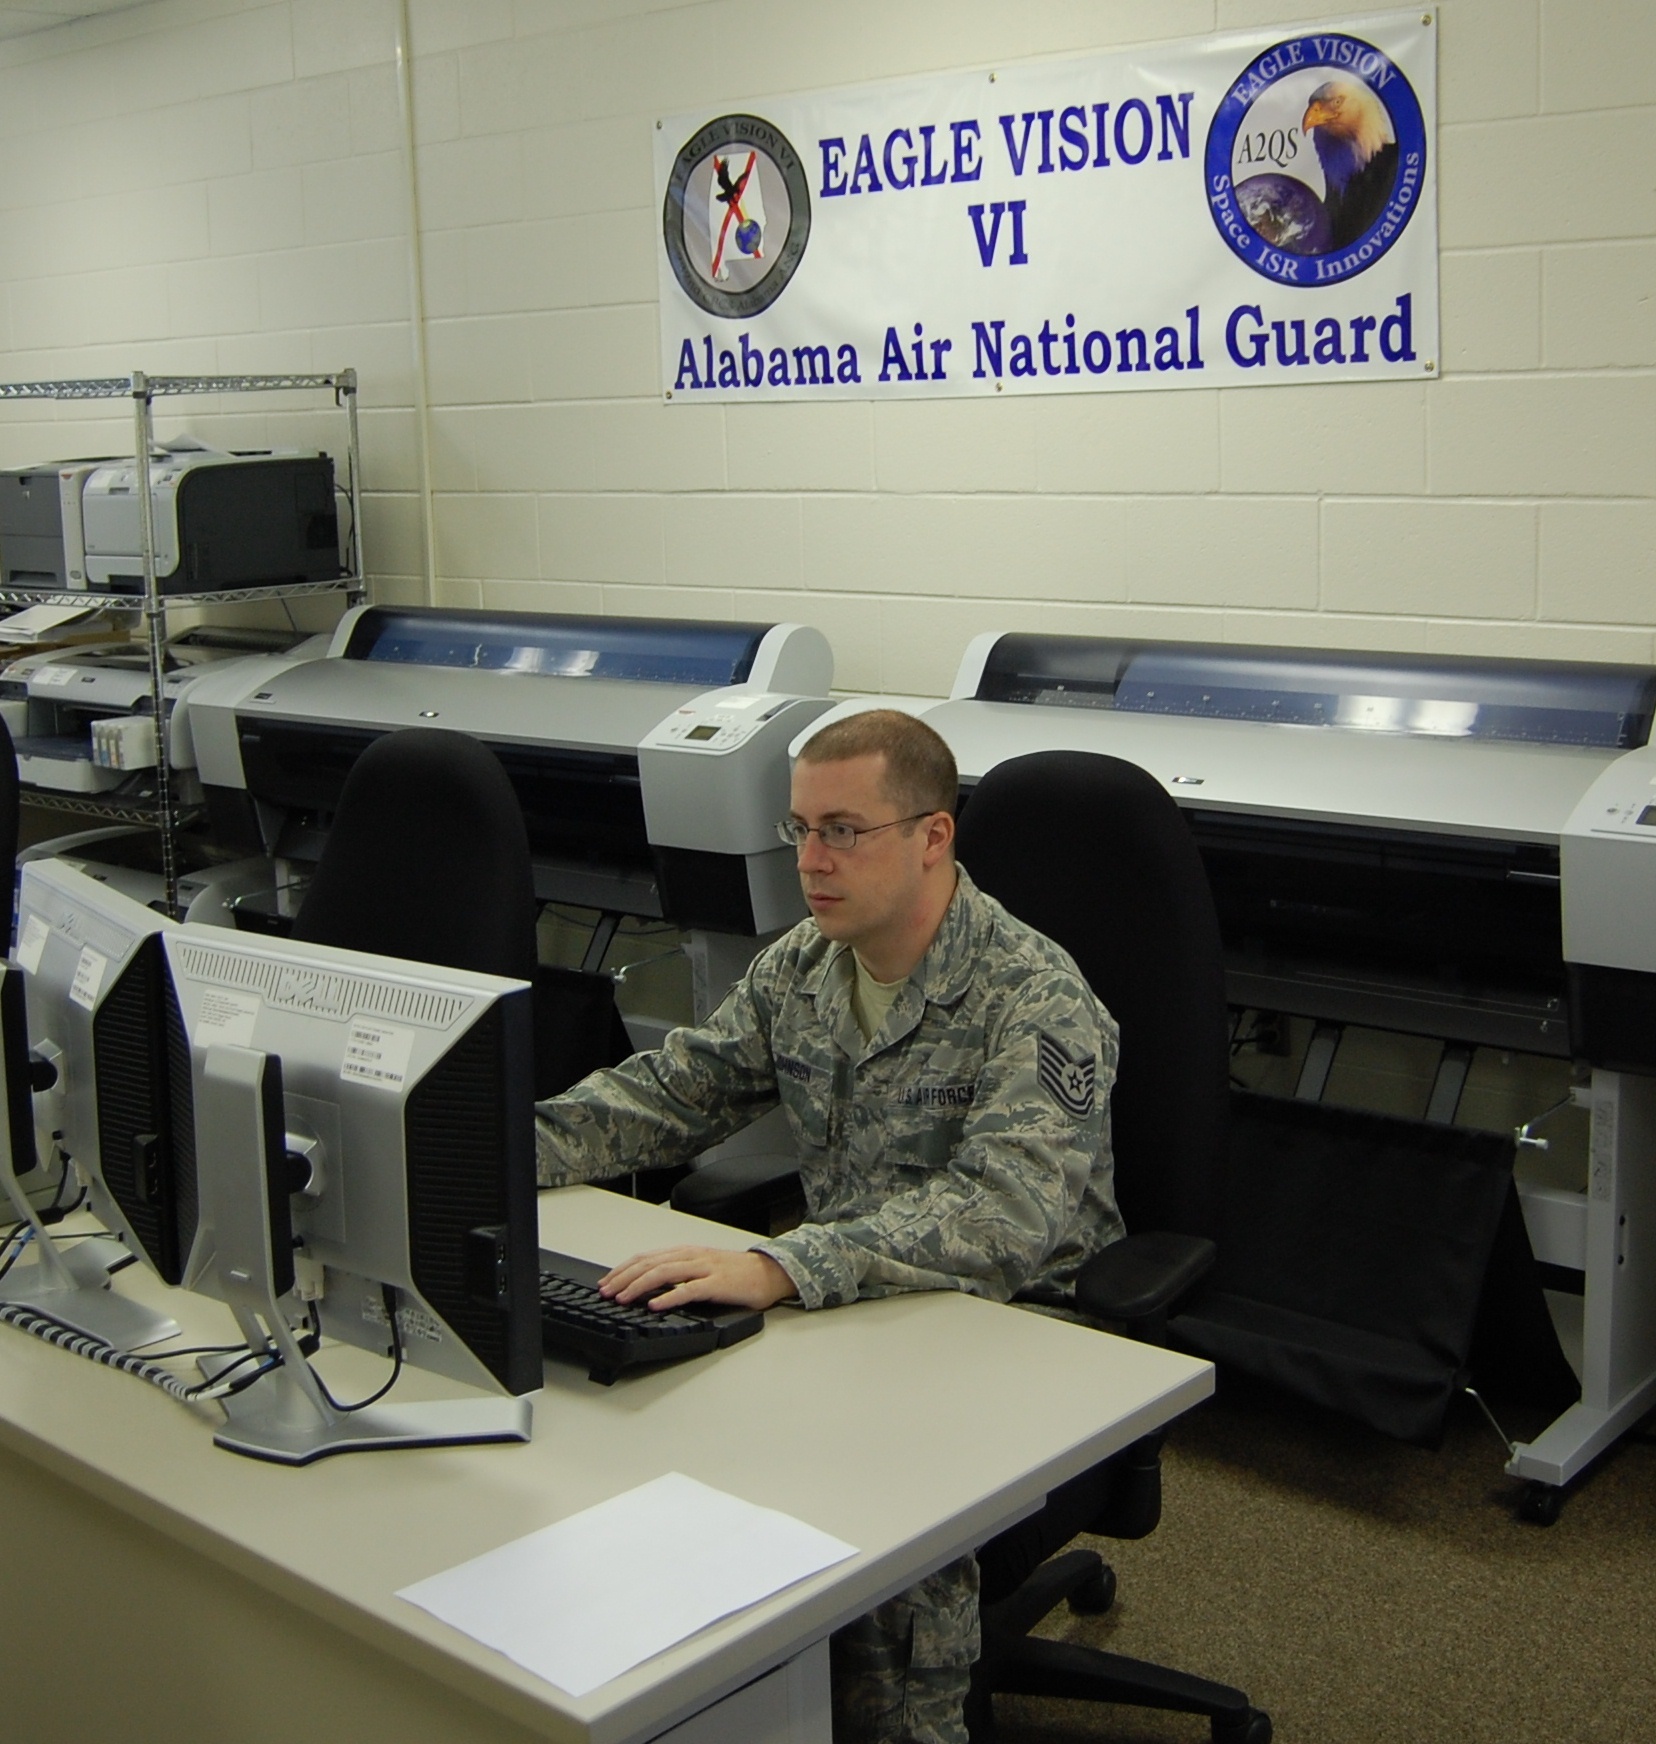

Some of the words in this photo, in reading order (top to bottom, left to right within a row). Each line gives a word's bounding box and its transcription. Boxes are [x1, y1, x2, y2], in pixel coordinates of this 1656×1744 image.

[1231, 41, 1304, 107] EAGLE
[1312, 37, 1396, 90] VISION
[722, 122, 779, 149] VISION
[779, 146, 797, 172] VI
[818, 119, 983, 198] EAGLE
[999, 92, 1194, 176] VISION
[1237, 127, 1299, 168] A2QS
[967, 199, 1028, 267] VI
[1211, 174, 1250, 249] Space
[1254, 246, 1299, 281] ISR
[1314, 151, 1419, 280] Innovations
[674, 332, 861, 390] Alabama
[878, 322, 952, 381] Air
[971, 305, 1204, 378] National
[1225, 292, 1416, 368] Guard
